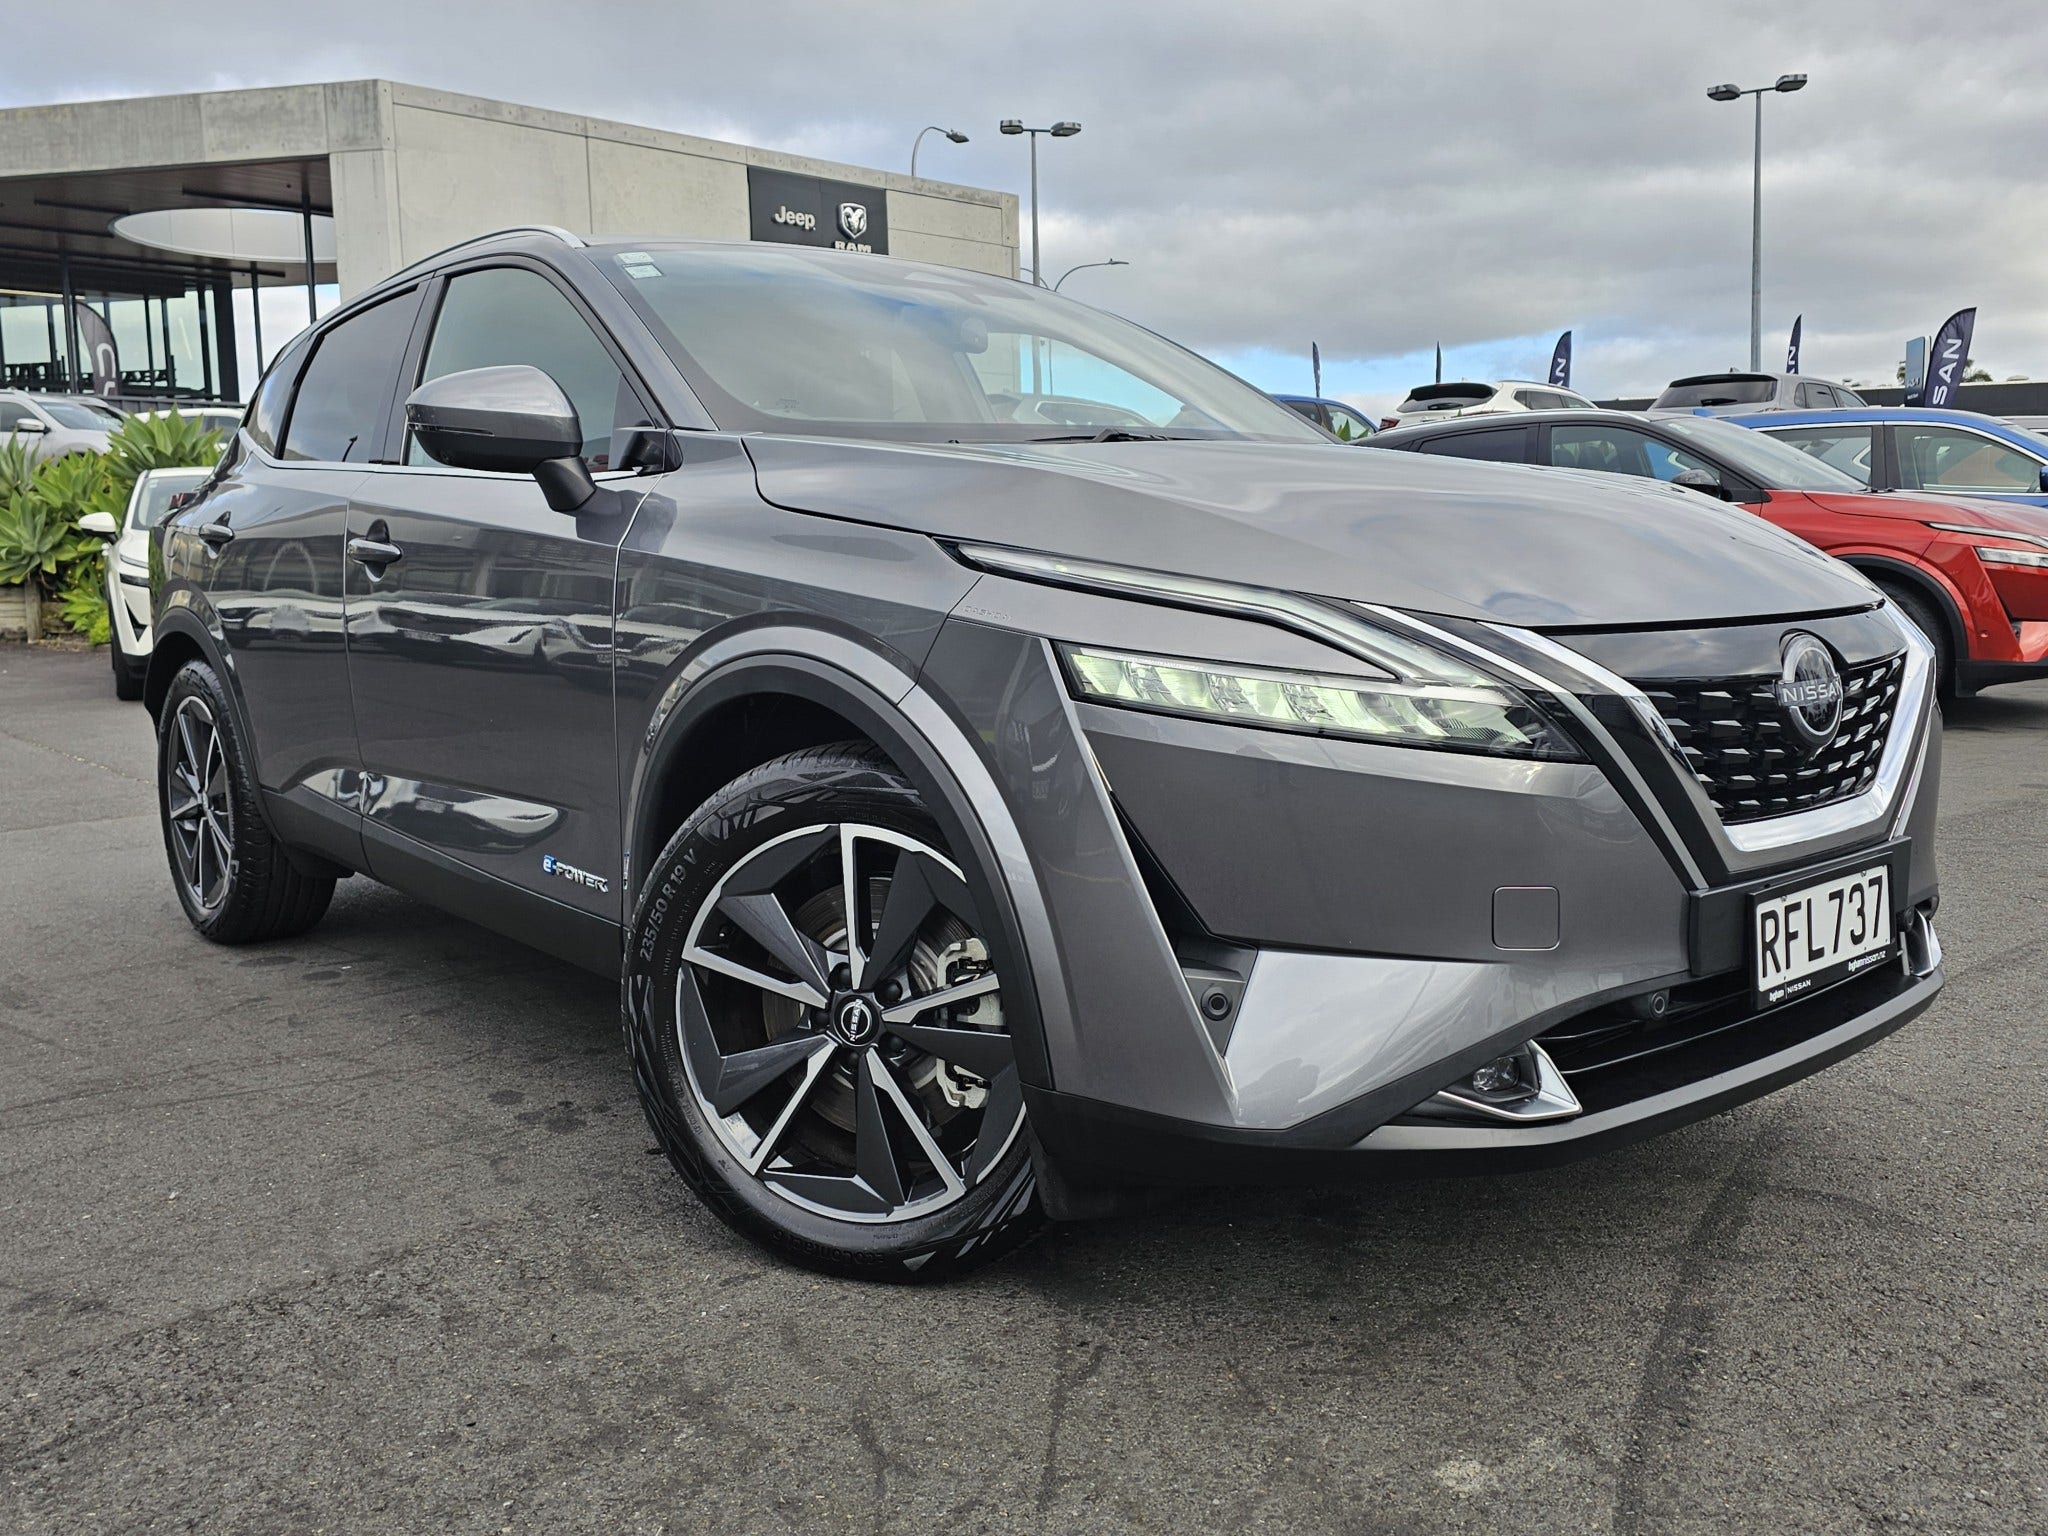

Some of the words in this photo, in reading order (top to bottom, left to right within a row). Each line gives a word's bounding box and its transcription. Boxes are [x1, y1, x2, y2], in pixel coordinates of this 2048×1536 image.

[774, 205, 816, 230] Jeep
[834, 240, 872, 254] RAM
[1782, 680, 1841, 703] NISSAN
[639, 897, 669, 962] 235/50
[661, 883, 676, 900] R
[670, 864, 688, 886] 19
[684, 848, 698, 865] V
[1760, 874, 1884, 979] RFL737
[1787, 979, 1811, 994] NISSAN
[849, 998, 863, 1042] NISSAN
